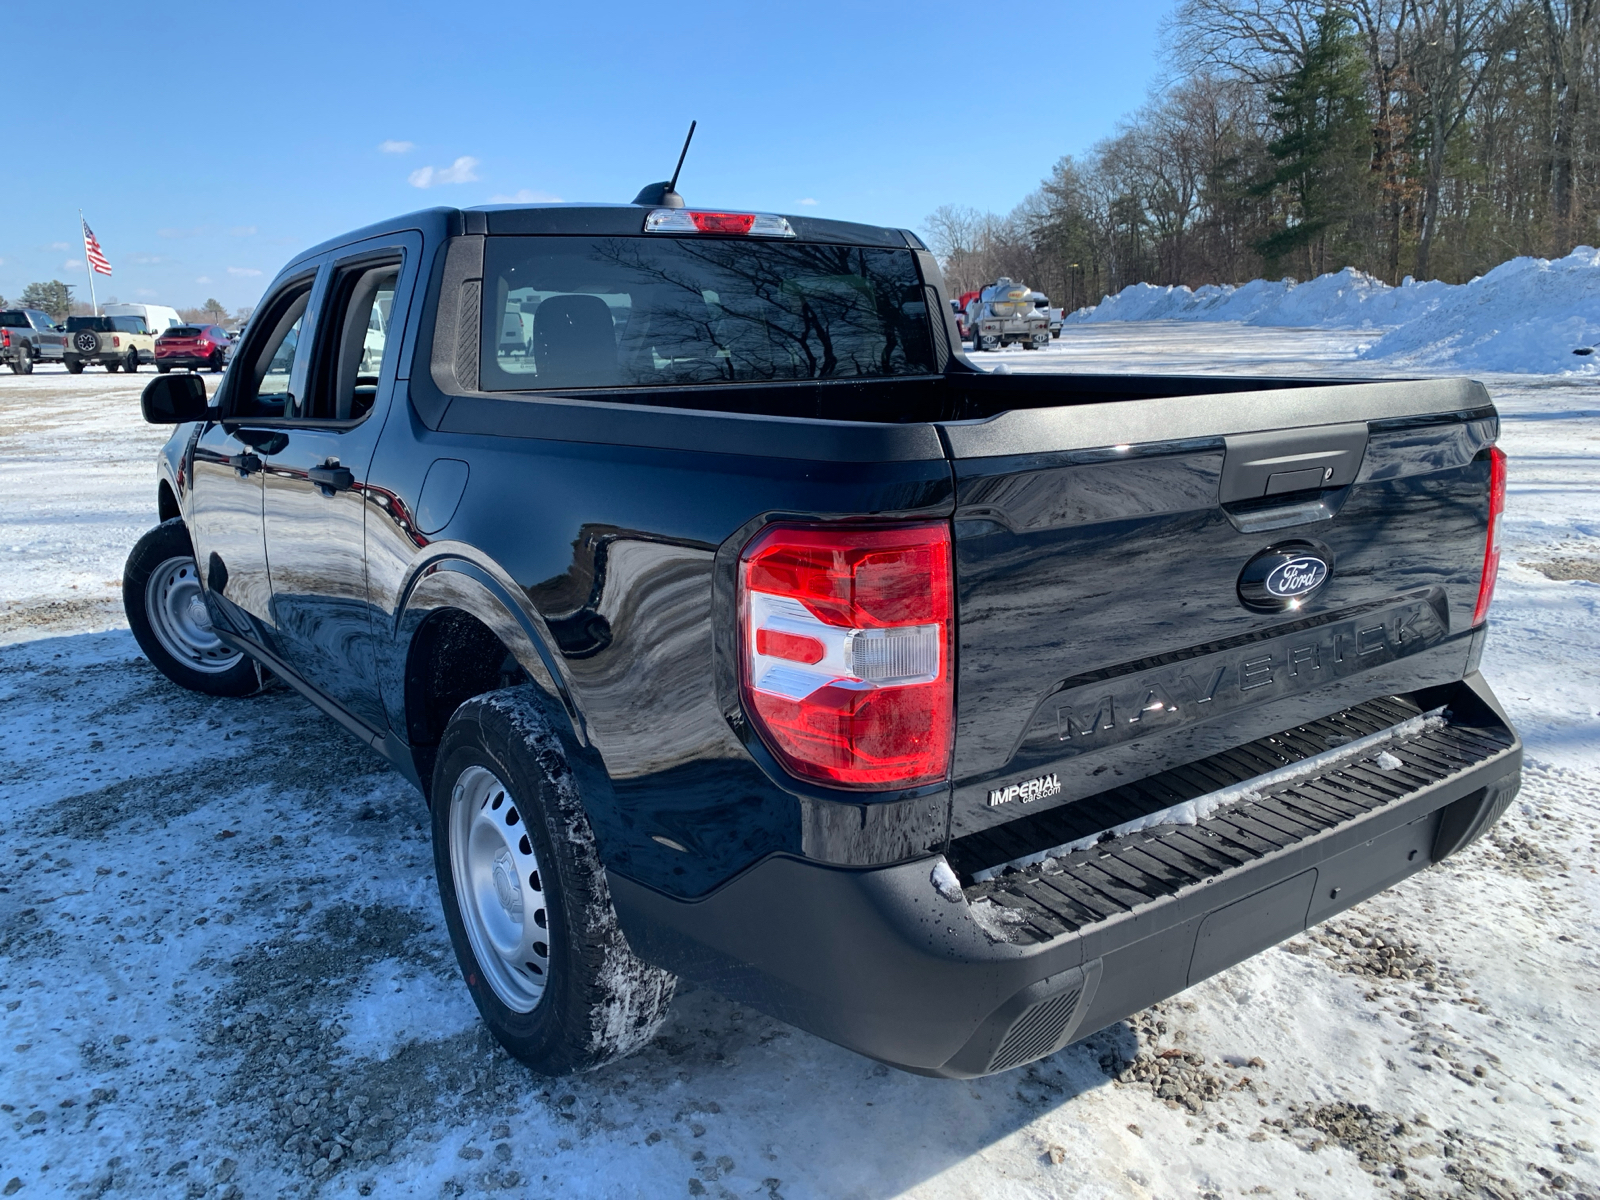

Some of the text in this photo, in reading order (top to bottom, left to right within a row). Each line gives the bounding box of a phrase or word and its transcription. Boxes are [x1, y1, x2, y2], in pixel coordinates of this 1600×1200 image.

[1279, 562, 1317, 592] Ford
[1056, 611, 1423, 741] MAVERICK
[988, 773, 1061, 806] IMPERIAL
[1022, 785, 1061, 804] cars.com
